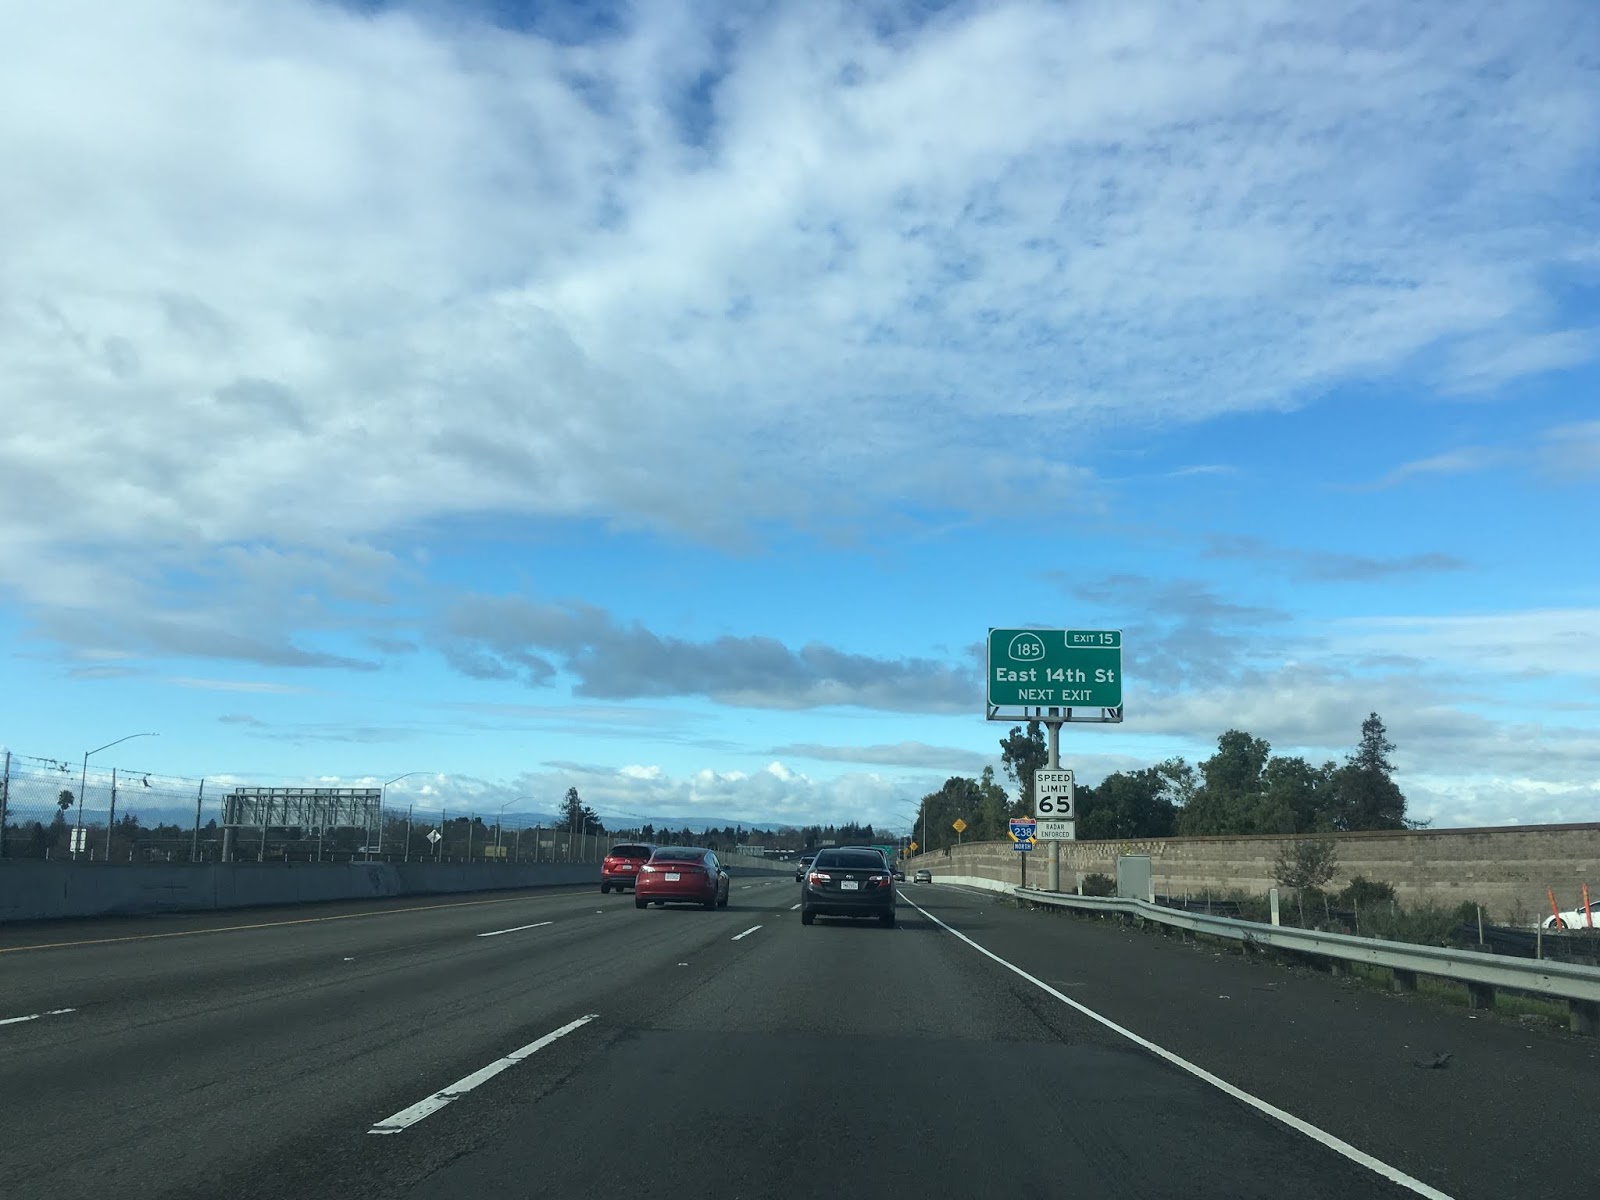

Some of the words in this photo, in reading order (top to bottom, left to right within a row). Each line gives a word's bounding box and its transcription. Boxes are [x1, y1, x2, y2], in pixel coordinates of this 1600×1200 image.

[1073, 634, 1095, 643] EXIT
[1099, 633, 1113, 645] 15
[1017, 643, 1040, 656] 185
[996, 667, 1037, 682] East
[1046, 667, 1086, 683] 14th
[1094, 668, 1115, 683] St
[1018, 688, 1054, 700] NEXT
[1062, 689, 1092, 701] EXIT
[1037, 774, 1071, 782] SPEED
[1041, 785, 1068, 793] LIMIT
[1038, 795, 1070, 813] 65
[1014, 827, 1032, 837] 238
